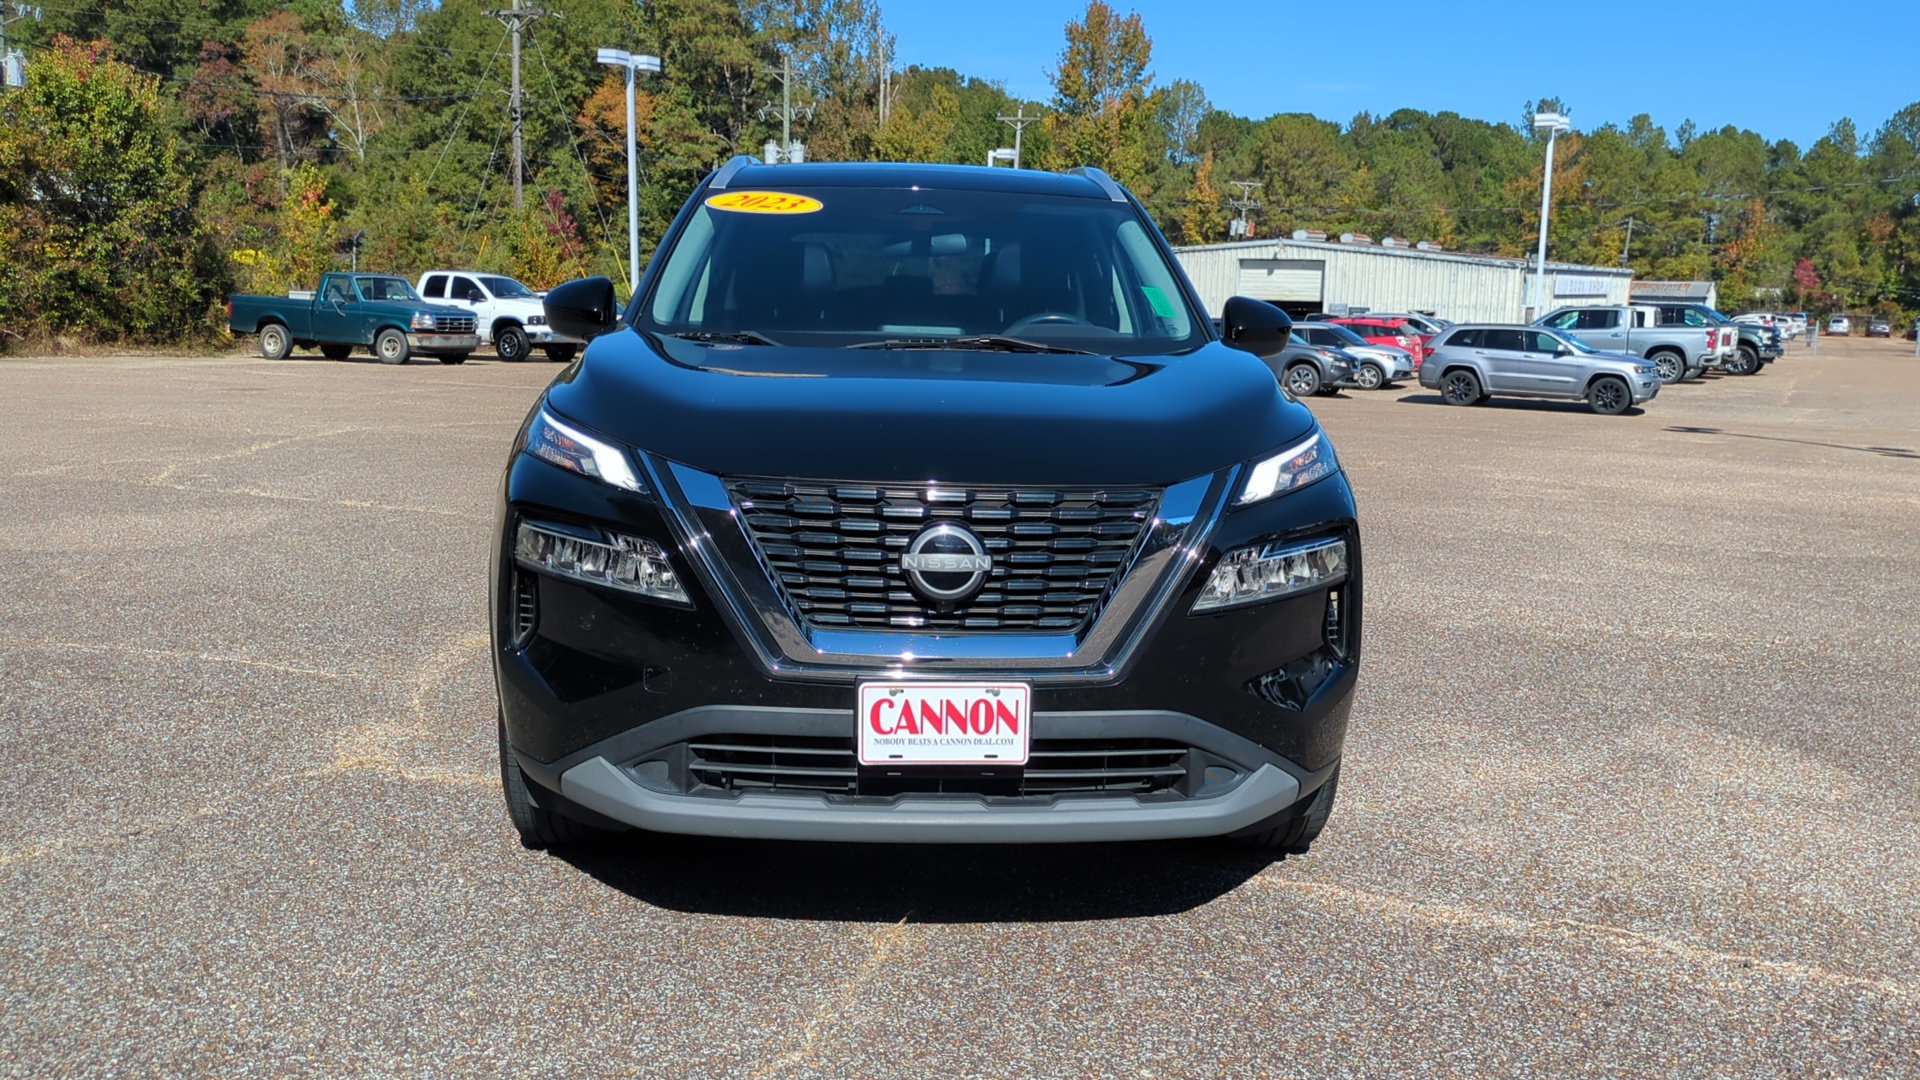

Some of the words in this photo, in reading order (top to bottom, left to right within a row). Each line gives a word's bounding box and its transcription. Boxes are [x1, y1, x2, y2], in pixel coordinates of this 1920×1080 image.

[720, 195, 806, 210] 2023
[904, 556, 988, 569] NISSAN
[869, 698, 1019, 735] CANNON
[873, 737, 906, 746] NOBODY
[908, 737, 932, 746] BEATS
[932, 738, 939, 746] A
[940, 737, 972, 746] CANNON
[973, 737, 1014, 746] DEAL.COM
